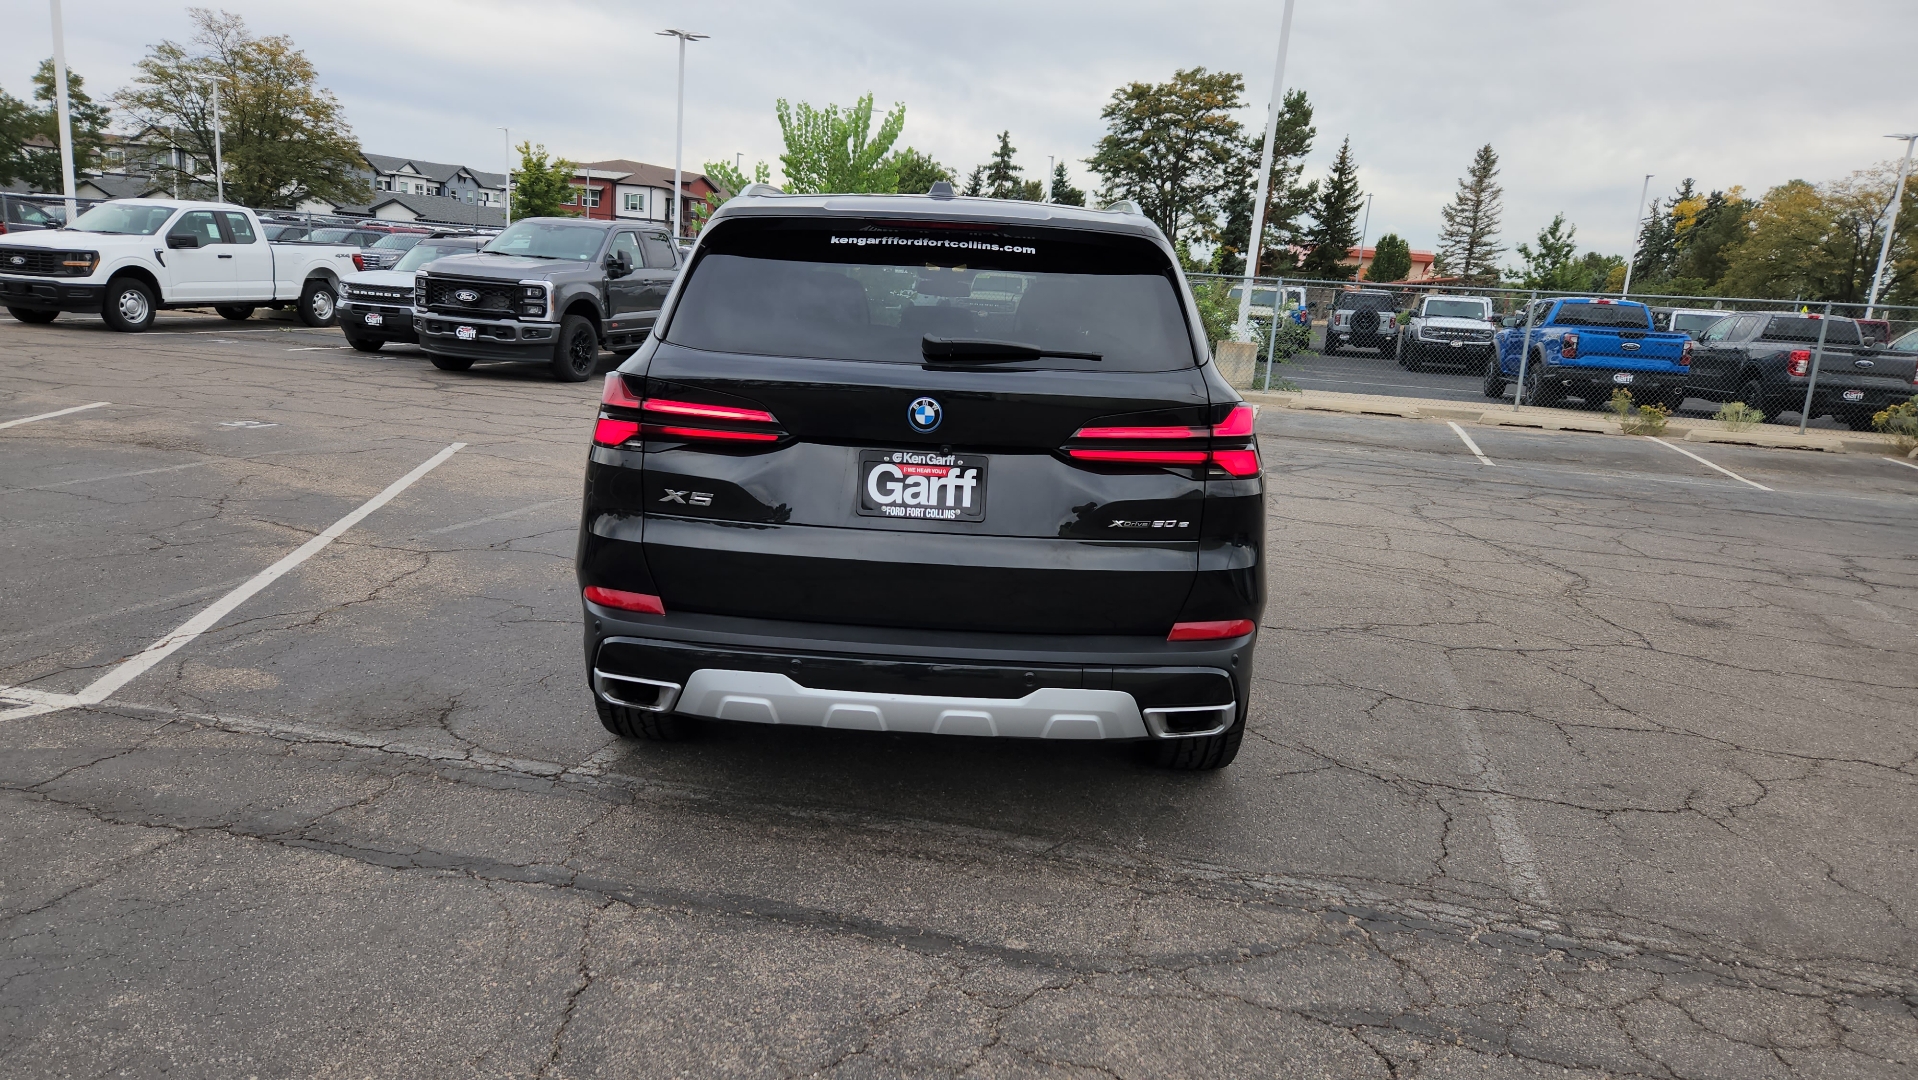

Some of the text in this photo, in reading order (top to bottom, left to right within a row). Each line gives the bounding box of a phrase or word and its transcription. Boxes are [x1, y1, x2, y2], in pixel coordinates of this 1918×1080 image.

[830, 235, 1036, 254] kengarfffordfortcollins.com
[353, 290, 401, 298] BRONCO
[455, 327, 477, 339] Garff
[903, 452, 956, 466] Ken Garff
[867, 463, 978, 508] Garff
[658, 488, 714, 507] X5
[886, 506, 956, 519] FORD FORT COLLINS
